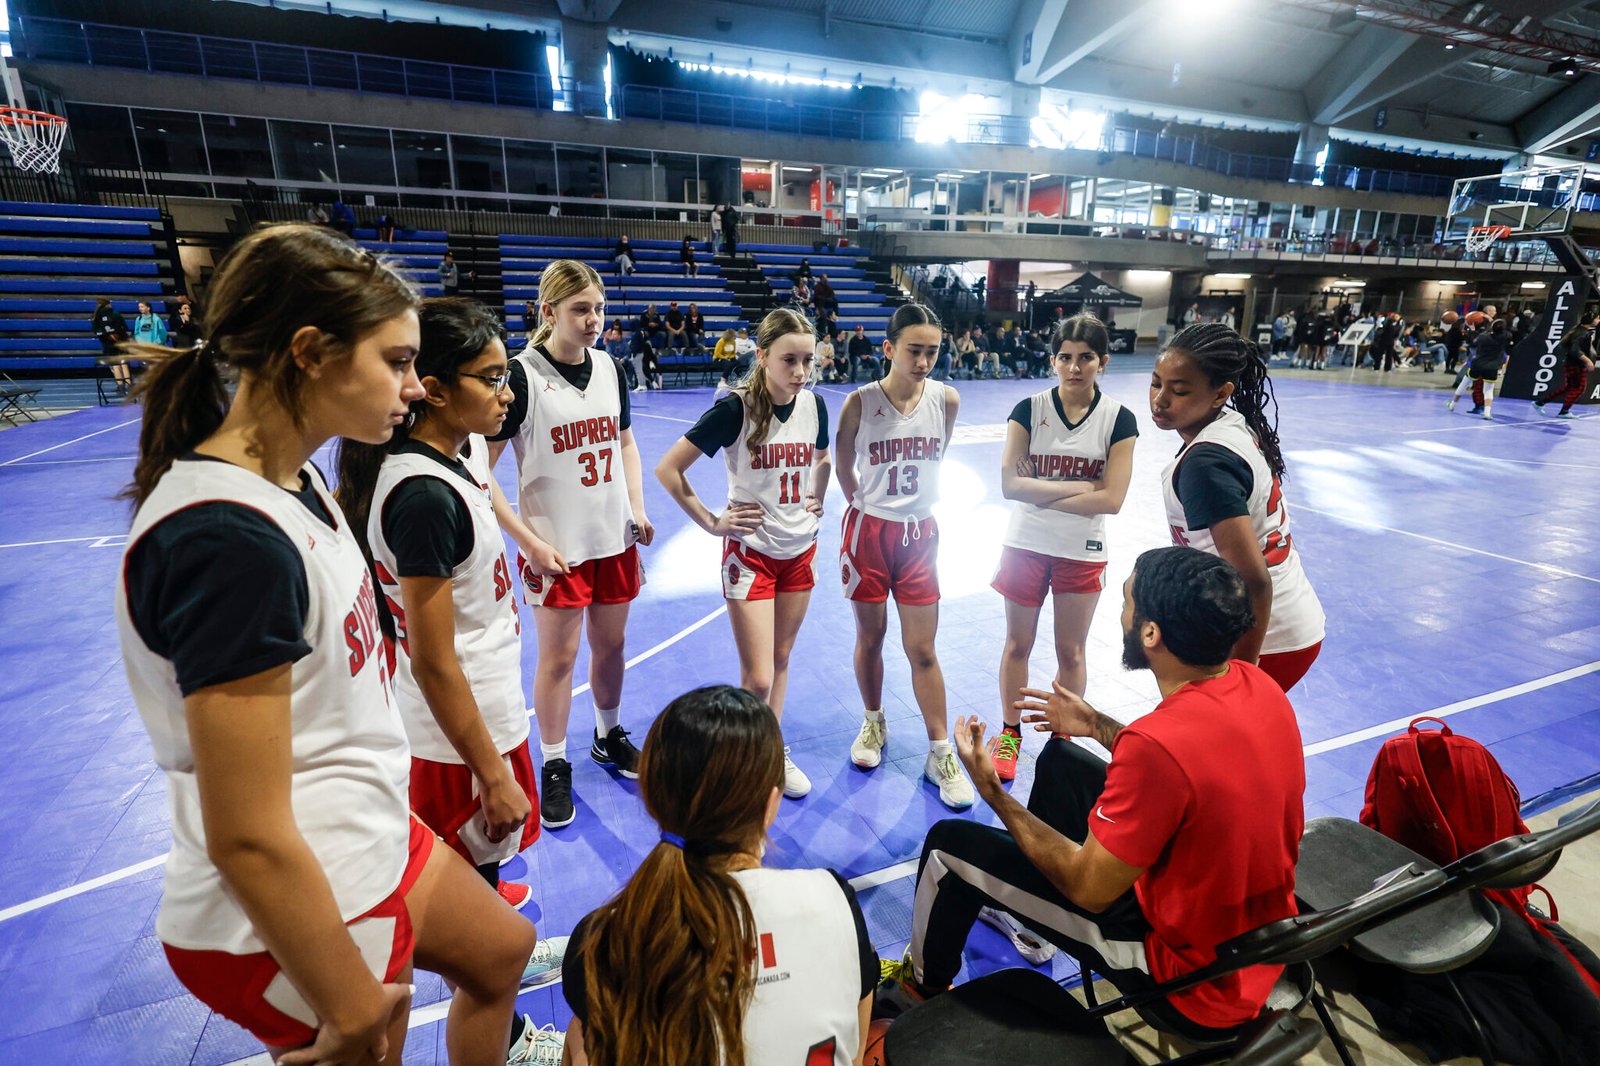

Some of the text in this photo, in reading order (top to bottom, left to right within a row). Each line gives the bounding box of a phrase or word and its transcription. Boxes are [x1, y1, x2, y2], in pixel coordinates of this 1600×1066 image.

[1533, 280, 1575, 396] ALLEYOOP
[550, 415, 619, 454] SUPREM
[869, 436, 941, 466] SUPREME
[577, 447, 613, 487] 37
[886, 464, 919, 496] 13
[779, 470, 801, 505] 11
